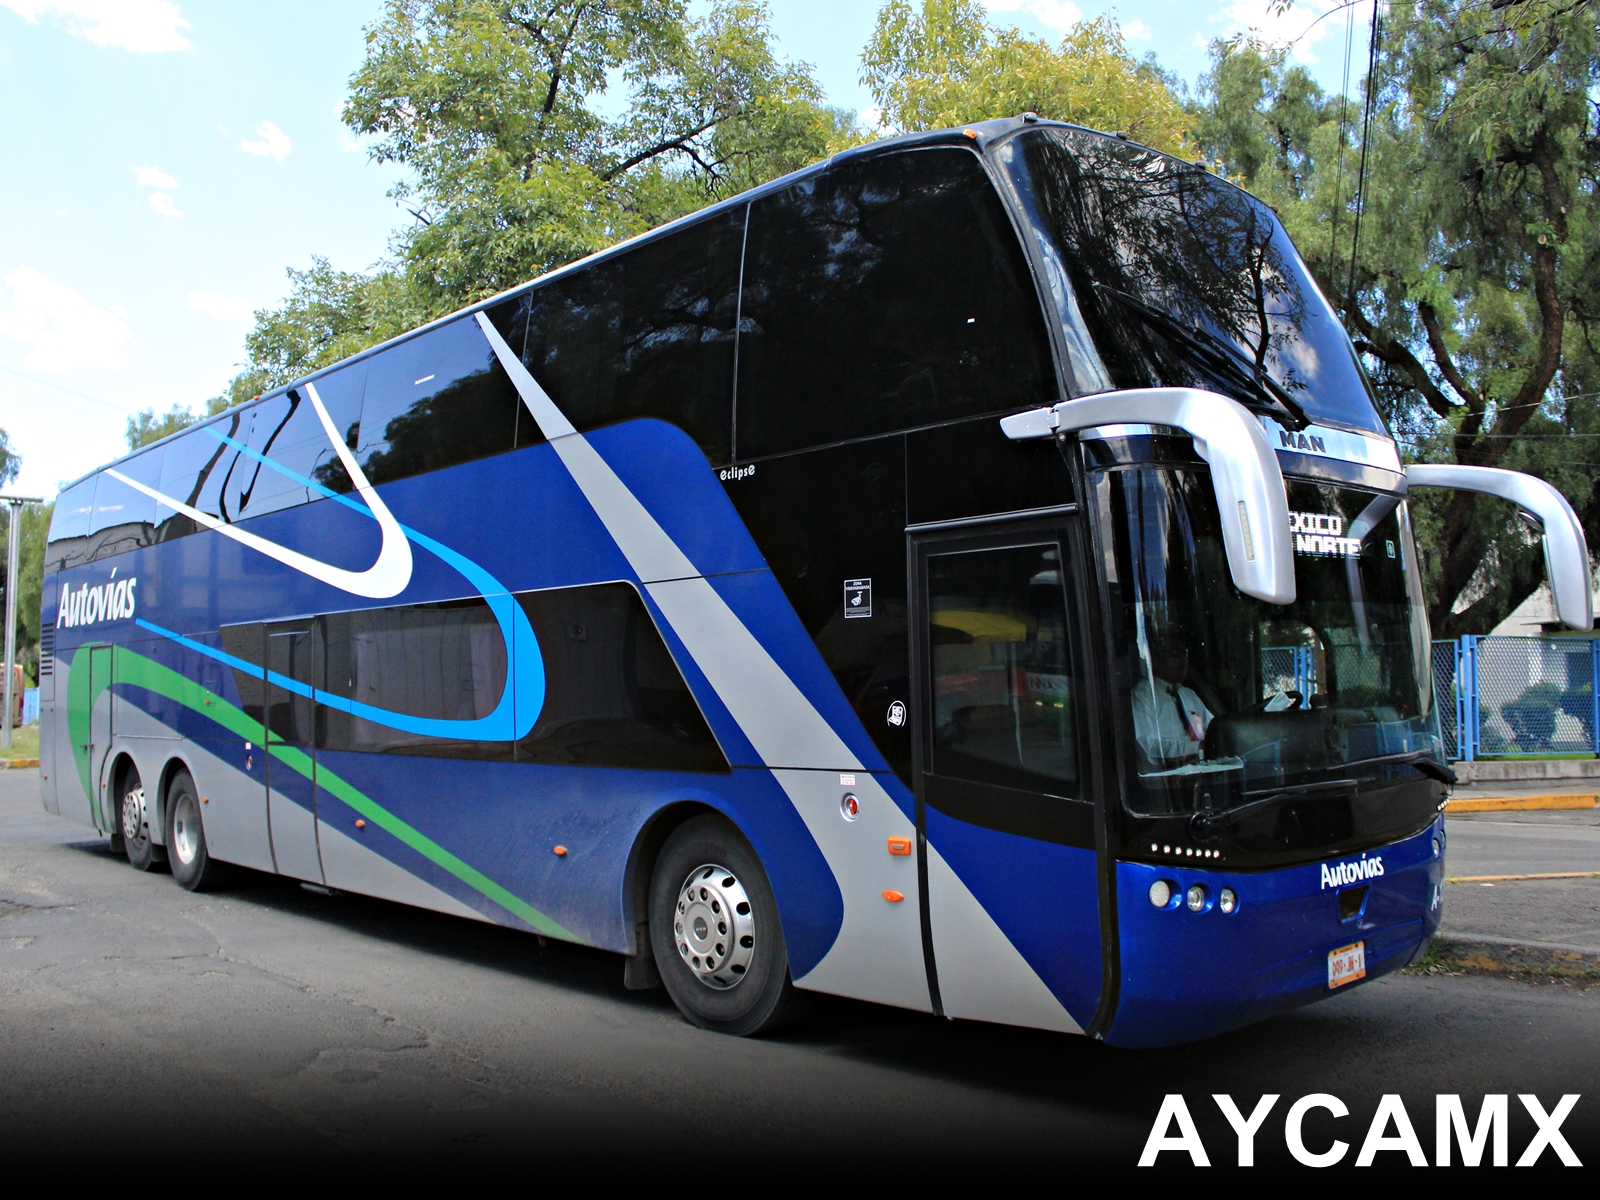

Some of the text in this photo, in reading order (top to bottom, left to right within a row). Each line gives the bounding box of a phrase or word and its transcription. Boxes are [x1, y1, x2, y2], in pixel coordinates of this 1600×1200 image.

[1279, 430, 1326, 453] MAN
[720, 464, 756, 481] eclipse
[1288, 510, 1342, 536] XICO
[56, 566, 137, 629] Autovías
[1321, 852, 1385, 890] Autovías
